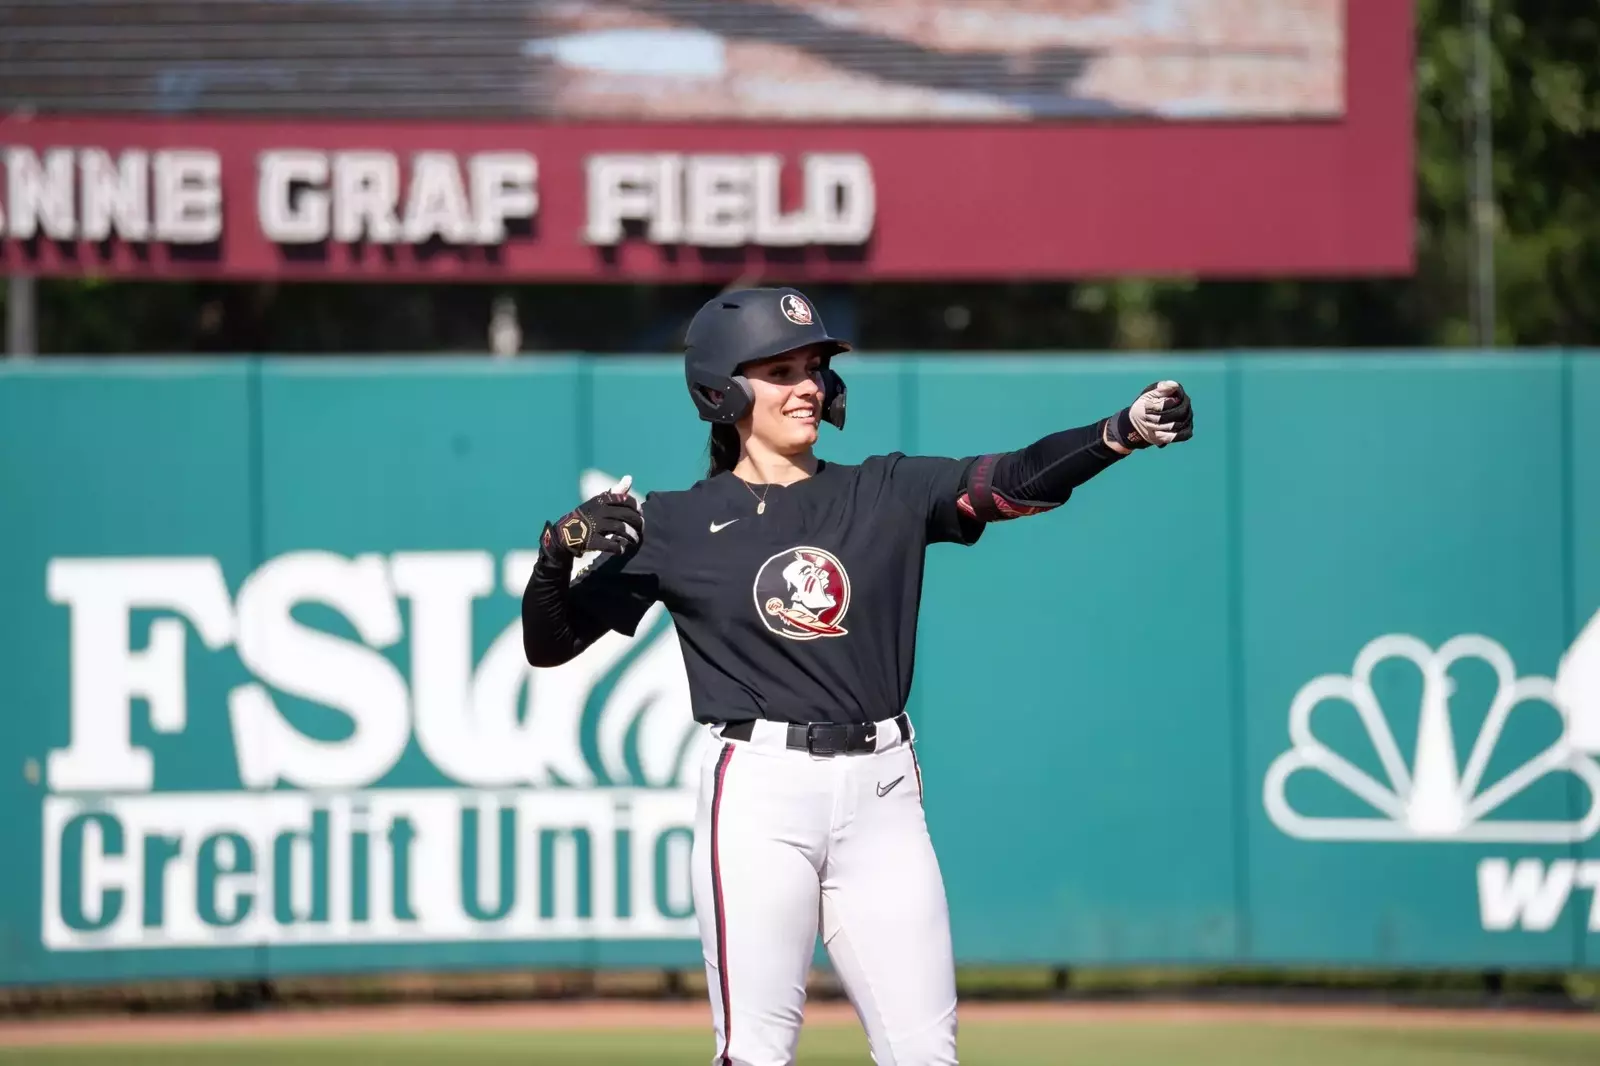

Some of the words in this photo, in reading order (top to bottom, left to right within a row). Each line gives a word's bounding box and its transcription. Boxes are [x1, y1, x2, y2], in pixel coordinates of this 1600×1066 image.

[0, 146, 222, 243] NNE
[258, 149, 538, 245] GRAF
[584, 150, 875, 247] FIELD
[46, 550, 602, 790] FSU
[60, 807, 418, 932] Credit
[459, 806, 697, 922] Unio
